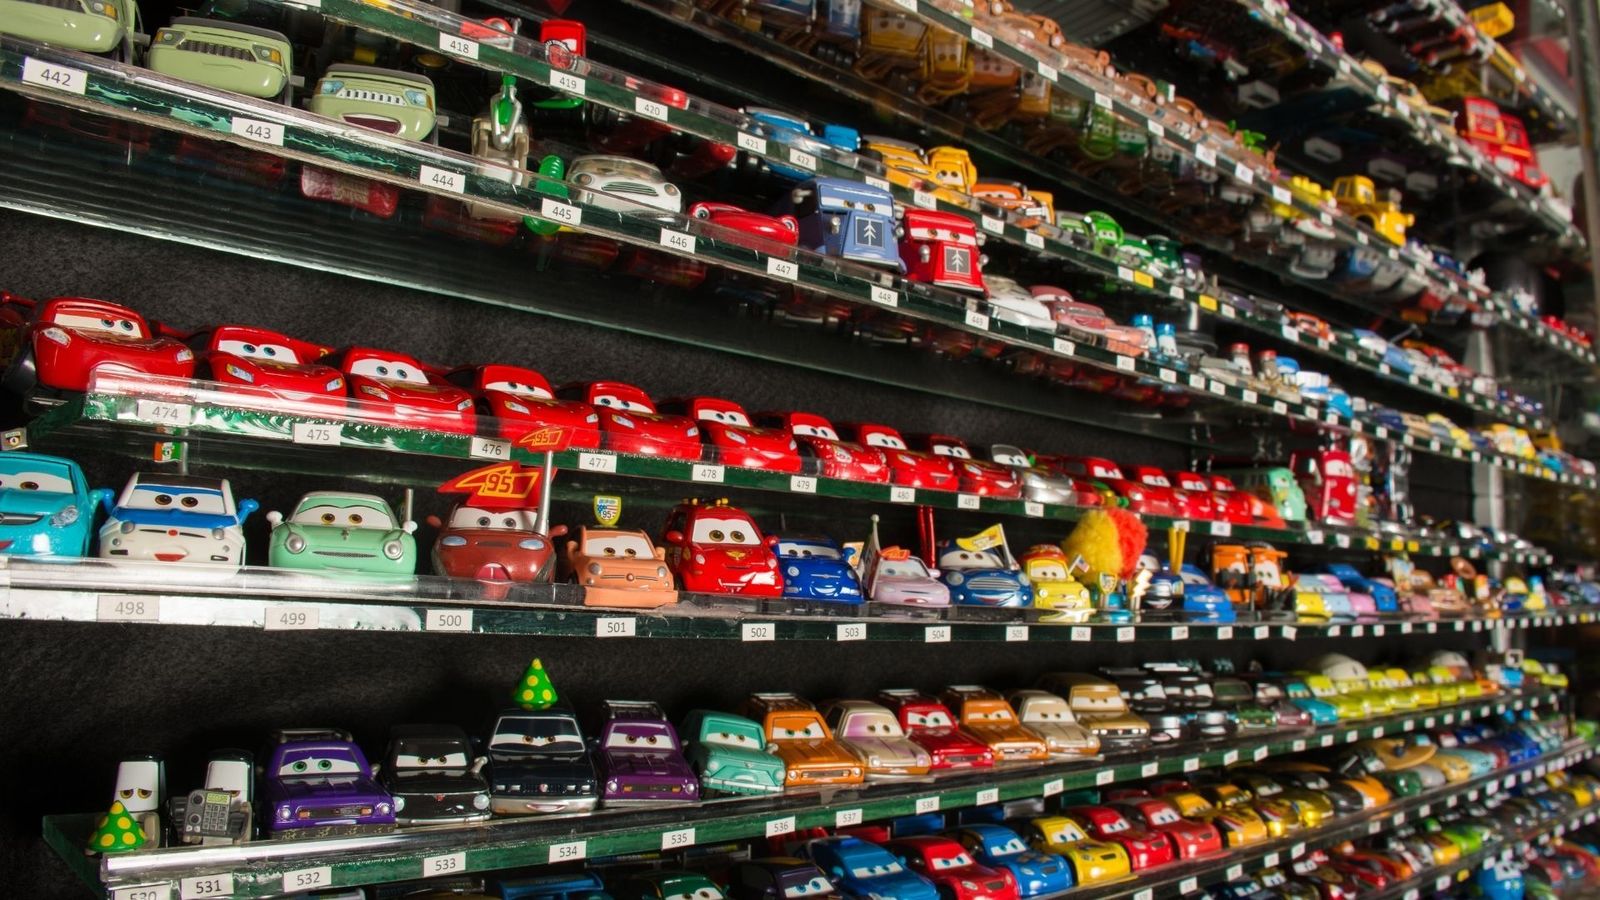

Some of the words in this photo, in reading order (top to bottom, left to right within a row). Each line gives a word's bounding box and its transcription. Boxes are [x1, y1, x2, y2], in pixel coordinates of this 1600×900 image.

[450, 41, 470, 54] 418
[41, 68, 71, 87] 442
[559, 77, 577, 90] 419
[644, 104, 661, 117] 420
[245, 124, 272, 140] 443
[745, 138, 759, 149] 421
[795, 154, 809, 166] 422
[432, 173, 454, 188] 444
[552, 205, 573, 221] 445
[670, 235, 687, 248] 446
[776, 265, 791, 276] 447
[878, 291, 892, 302] 448
[152, 405, 179, 420] 474
[306, 427, 330, 441] 475
[482, 443, 502, 455] 476
[588, 456, 607, 469] 477
[701, 468, 717, 480] 478
[487, 473, 513, 493] 95
[796, 480, 810, 490] 479
[115, 601, 145, 615] 498
[279, 612, 306, 625] 499
[438, 614, 462, 627] 500
[606, 621, 626, 634] 501
[751, 627, 767, 638] 502
[845, 628, 859, 638] 503
[932, 630, 945, 639] 504
[843, 813, 856, 823] 537
[774, 821, 789, 832] 536
[671, 832, 688, 845] 535
[559, 844, 578, 858] 534
[435, 857, 456, 871] 533
[296, 871, 320, 885] 532
[195, 879, 222, 894] 531
